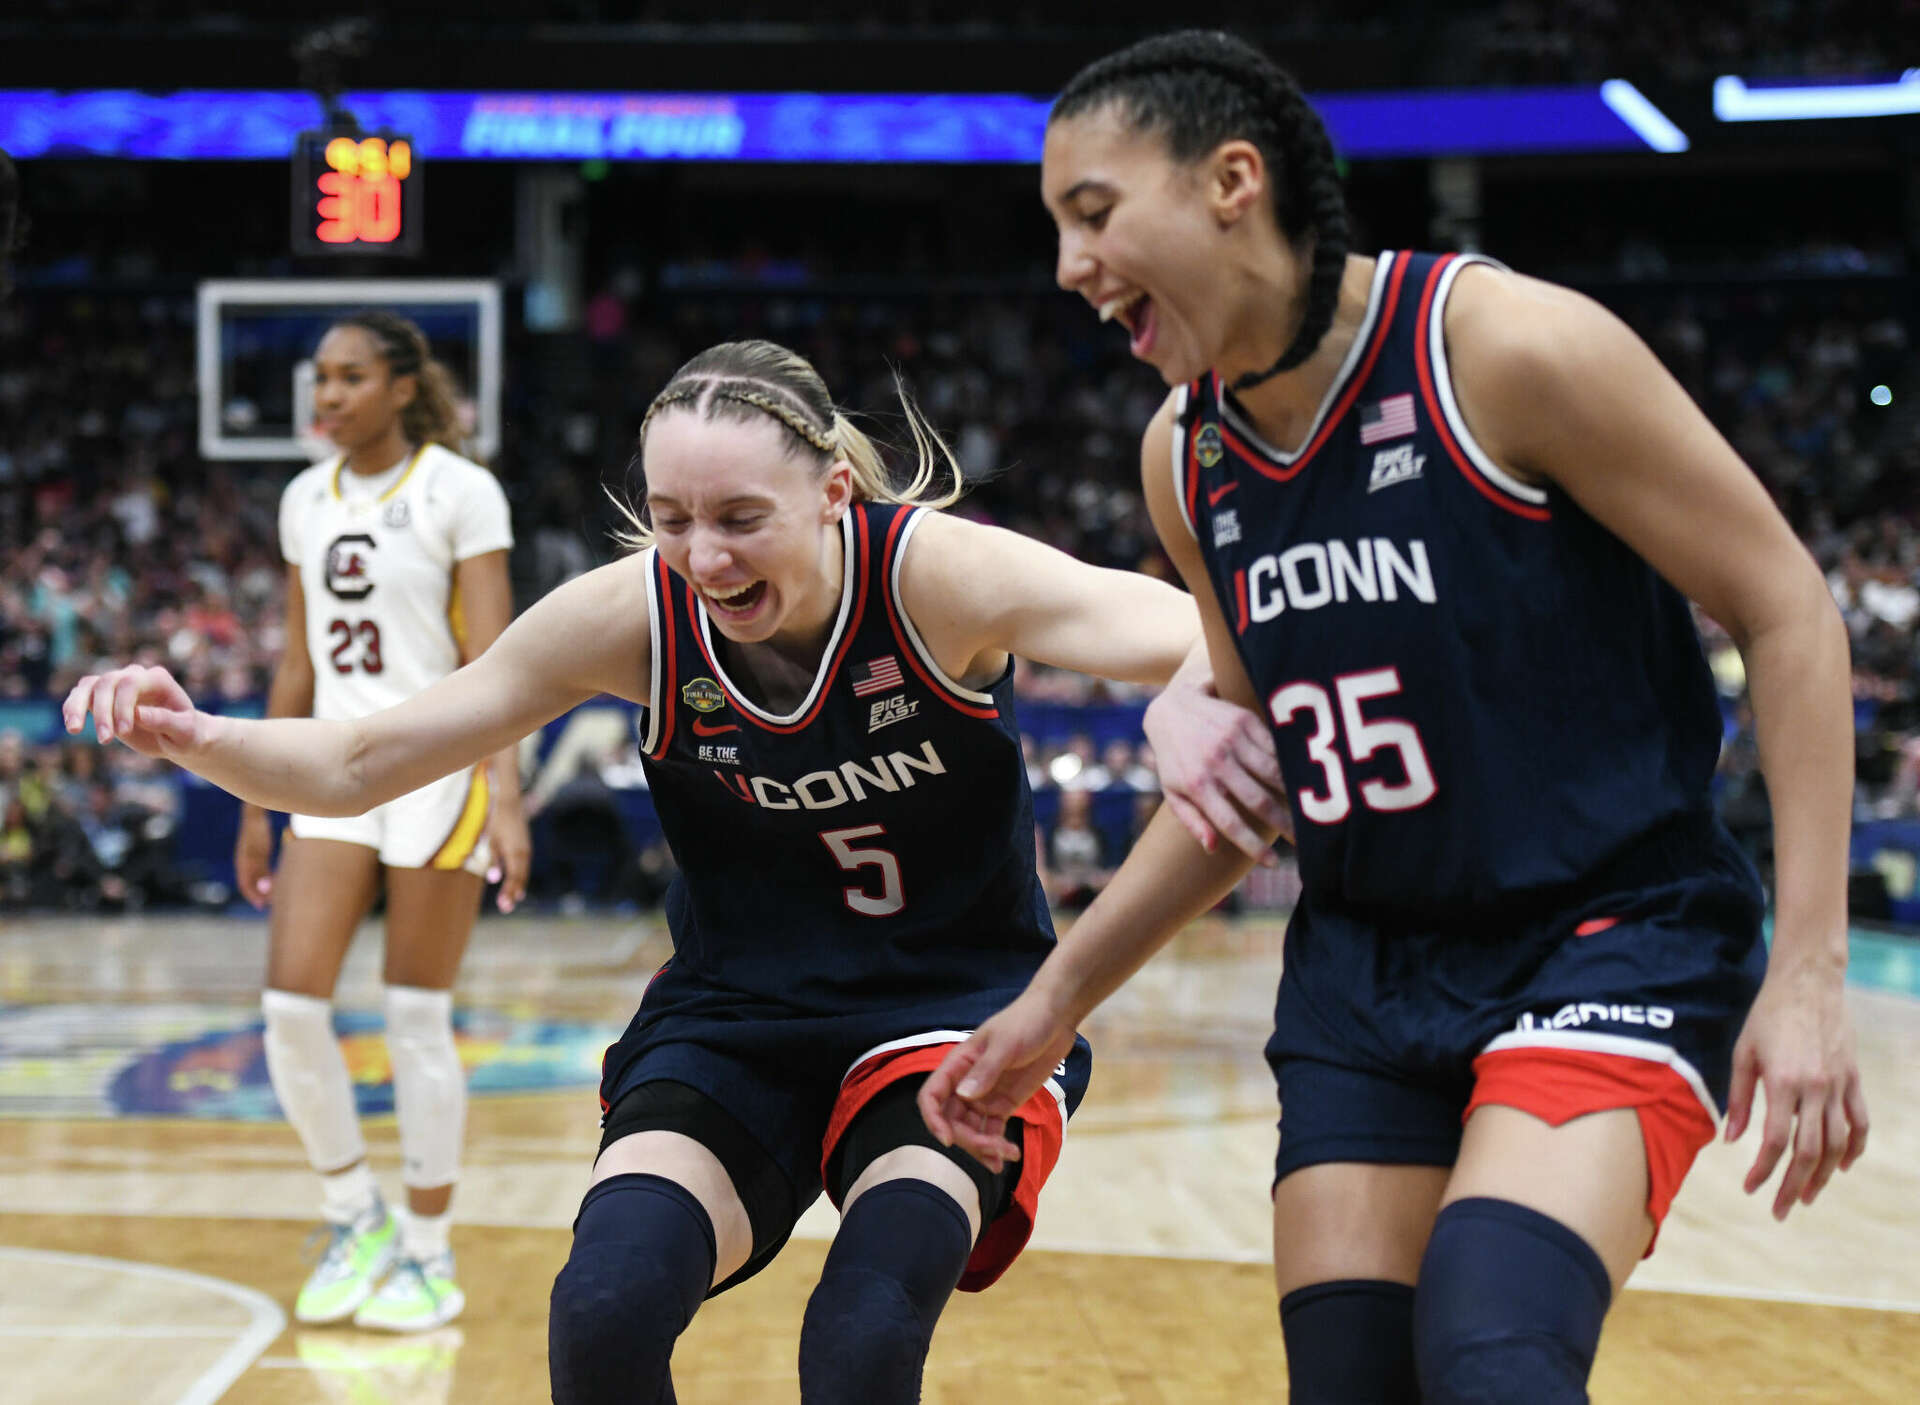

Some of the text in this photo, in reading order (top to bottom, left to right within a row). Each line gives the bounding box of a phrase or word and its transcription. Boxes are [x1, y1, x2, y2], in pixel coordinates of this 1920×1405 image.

[316, 171, 401, 243] 30
[329, 619, 384, 674] 23
[869, 700, 920, 727] EAST
[870, 695, 905, 715] BIG
[699, 745, 738, 759] BE THE
[713, 740, 948, 810] UCONN
[1268, 666, 1439, 826] 35
[818, 824, 907, 918] 5
